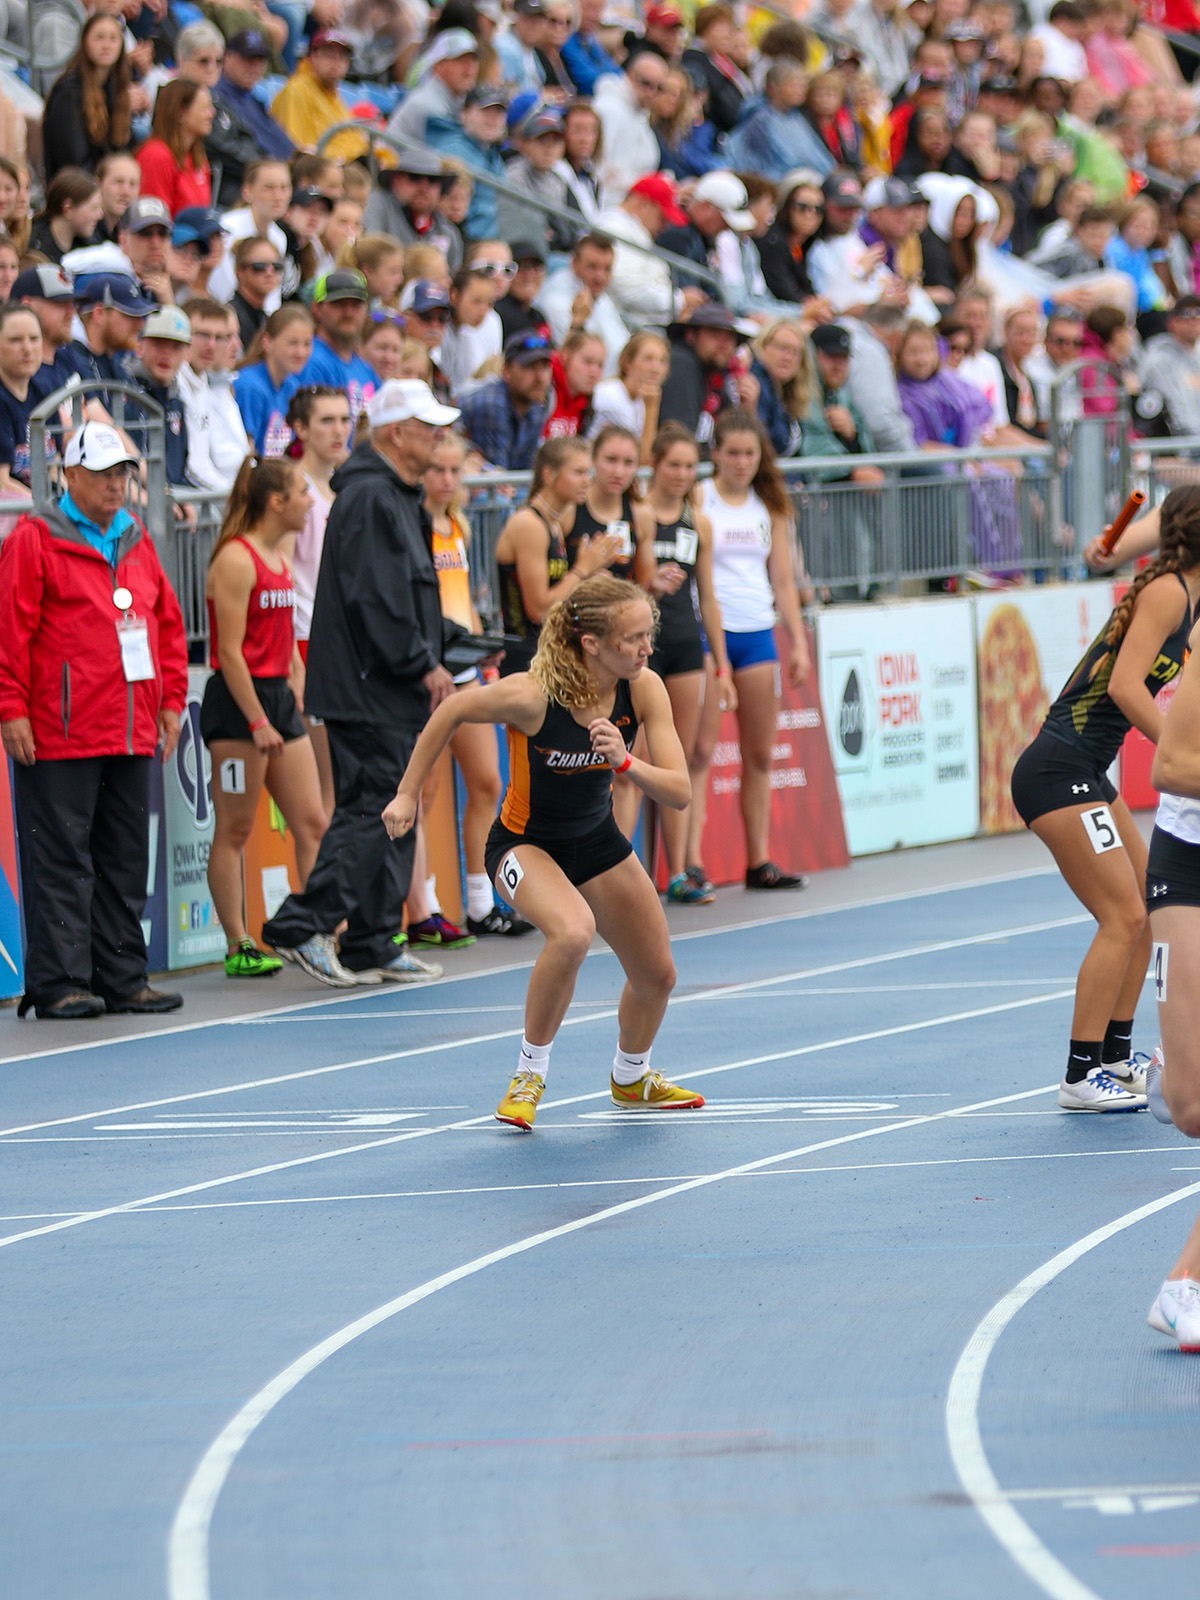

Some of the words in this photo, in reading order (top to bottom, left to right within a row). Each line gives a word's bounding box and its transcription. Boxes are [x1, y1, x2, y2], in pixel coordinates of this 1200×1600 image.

[876, 653, 921, 687] IOWA
[1149, 653, 1183, 682] CA
[879, 693, 924, 727] PORK
[546, 750, 605, 767] CHARLES
[226, 763, 237, 790] 1
[1090, 810, 1115, 848] 5
[173, 843, 197, 867] IOWA
[503, 859, 518, 890] 6
[1155, 946, 1165, 998] 4
